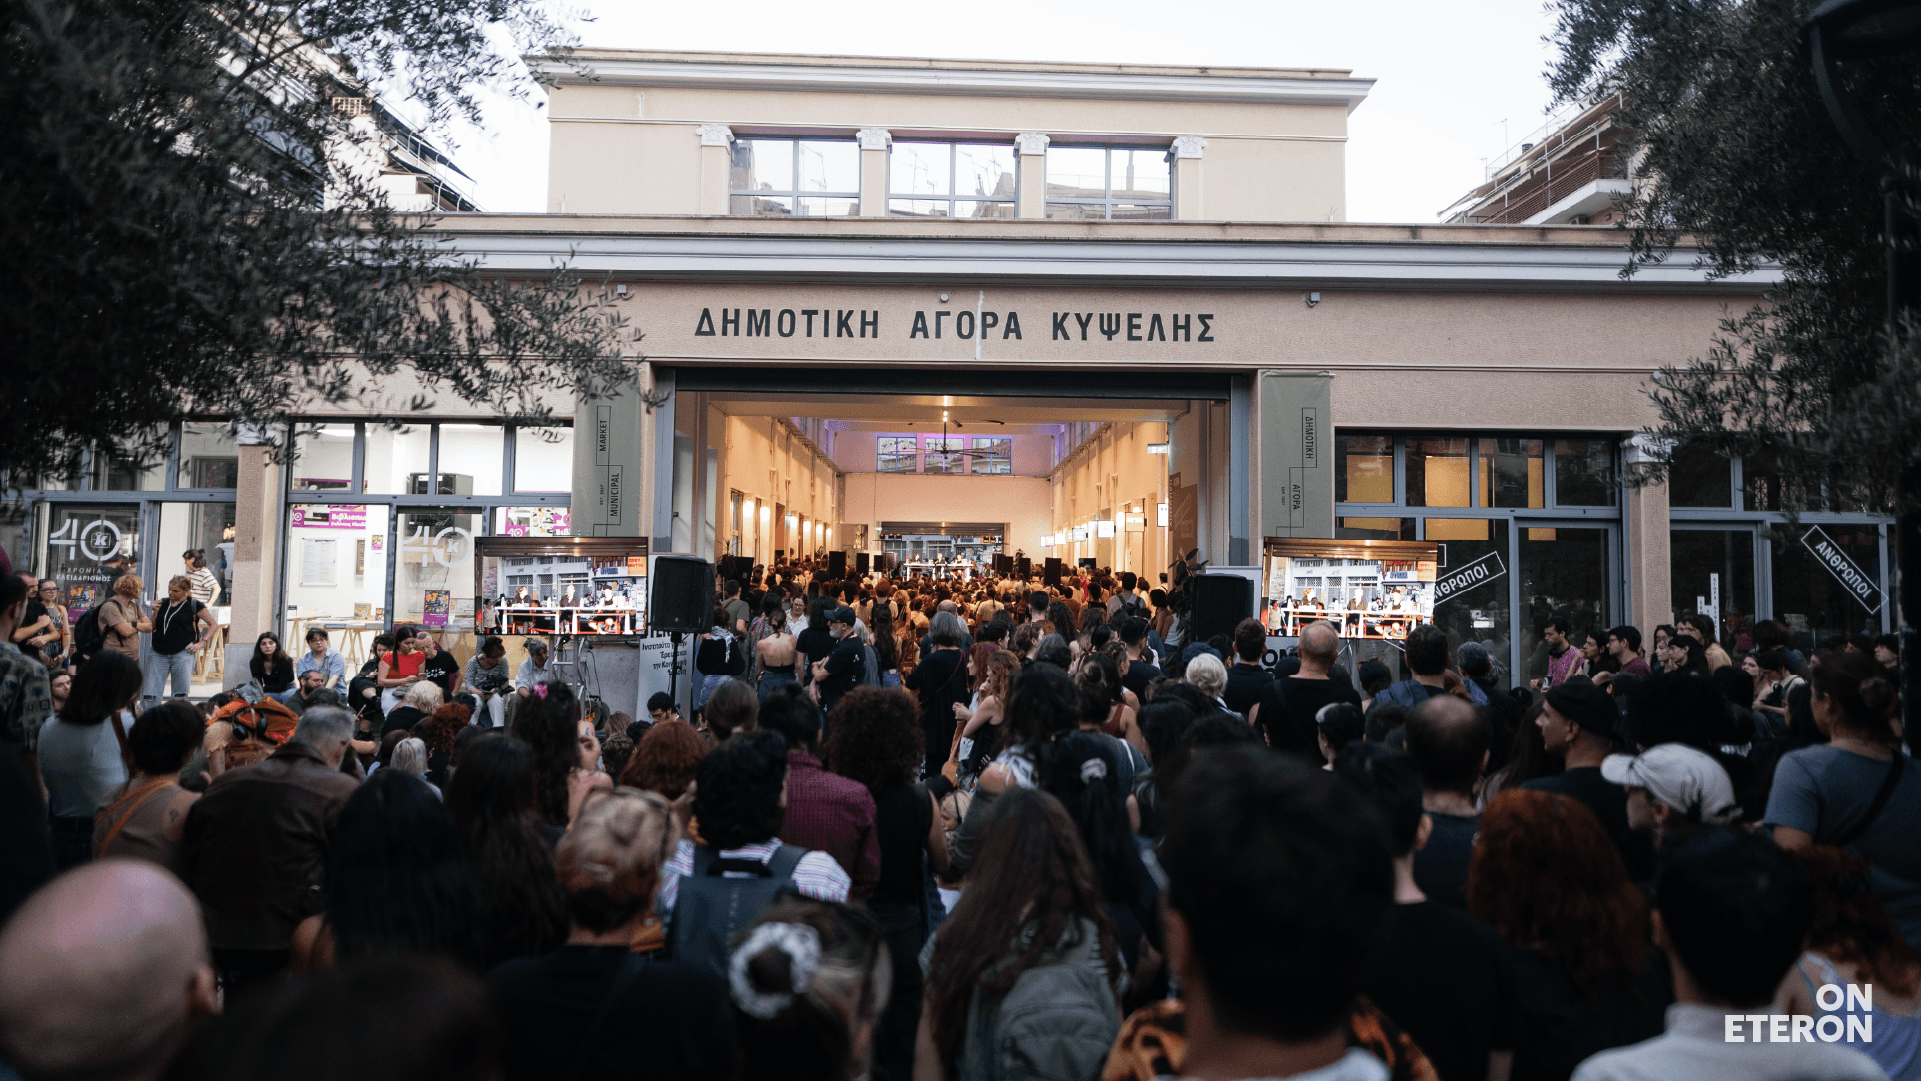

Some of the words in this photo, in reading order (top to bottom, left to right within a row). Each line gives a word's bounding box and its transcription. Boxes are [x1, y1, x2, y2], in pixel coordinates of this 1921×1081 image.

[694, 307, 879, 339] ΔΗΜΟΤΙΚΗ
[909, 310, 1023, 340] ΑΓΟΡΑ
[1052, 311, 1215, 343] ΚΥΨΕΛΗΣ
[599, 419, 607, 452] MARKET
[1305, 416, 1314, 459] ΔΗΜΟΤΙΚΗ
[610, 473, 619, 517] MUNICIPAL
[1292, 484, 1301, 510] ΑΓΟΡΑ
[49, 518, 121, 561] 40
[402, 526, 473, 567] 40
[1434, 563, 1489, 599] ΝΘΡΩΠΟΙ
[1815, 541, 1872, 599] ΑΝΘΡΩΠΟΙ
[642, 642, 671, 651] Ινστιτούτο
